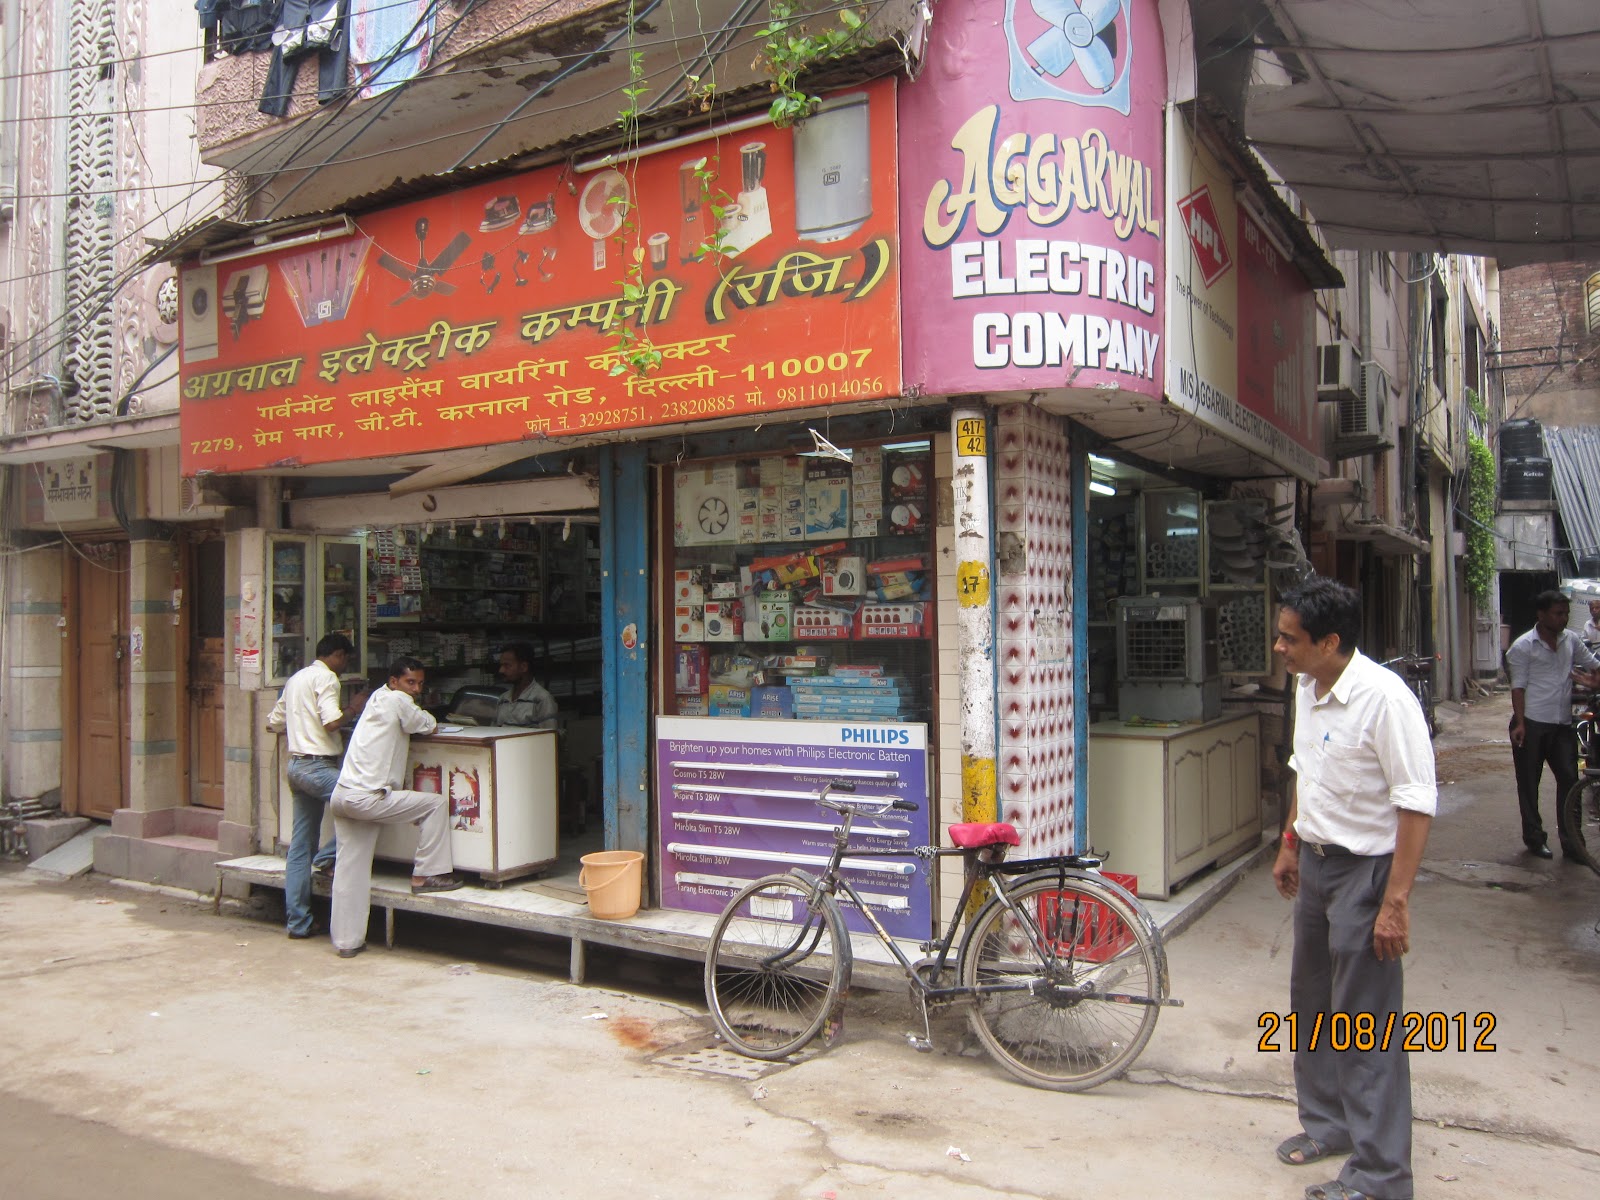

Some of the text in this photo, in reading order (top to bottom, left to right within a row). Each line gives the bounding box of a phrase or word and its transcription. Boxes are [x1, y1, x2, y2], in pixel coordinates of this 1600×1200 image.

[923, 104, 1161, 249] AGGARWAL
[1190, 207, 1222, 265] HPL
[951, 239, 1156, 315] ELECTRIC
[973, 311, 1160, 382] COMPANY
[183, 357, 302, 399] अग्रवाल
[319, 320, 497, 381] इलेक्ट्रीक
[458, 356, 568, 390] वायरिंग
[525, 413, 550, 433] फोन
[579, 406, 653, 429] 32928751,
[661, 394, 735, 419] 23820885
[745, 389, 766, 407] मो.
[777, 376, 883, 404] 9811014056
[1195, 380, 1234, 425] AGGARWAL
[1235, 404, 1263, 441] ELECTRIC
[190, 437, 243, 455] 7279,
[253, 428, 282, 448] प्रेम
[293, 423, 344, 441] नगर,
[354, 408, 422, 433] जी.टी.
[437, 396, 530, 422] करनाल
[546, 384, 607, 405] रोड,
[962, 577, 979, 594] 17
[762, 693, 779, 702] ARISE
[841, 727, 909, 745] PHILIPS
[669, 741, 911, 762] Brighten up your homes with Philips Electronic Batten
[673, 769, 697, 779] Cosmo
[709, 770, 725, 780] 28W
[875, 780, 891, 788] quality
[674, 791, 694, 801] Aspire
[705, 793, 721, 802] 28W
[698, 823, 712, 834] Slim
[724, 826, 740, 835] 28W
[876, 837, 892, 846] Energy
[699, 854, 713, 864] Slim
[714, 856, 730, 865] 36W
[877, 871, 892, 880] Energy
[677, 882, 697, 894] Tarang
[698, 886, 729, 897] Electronic
[899, 883, 910, 891] caps
